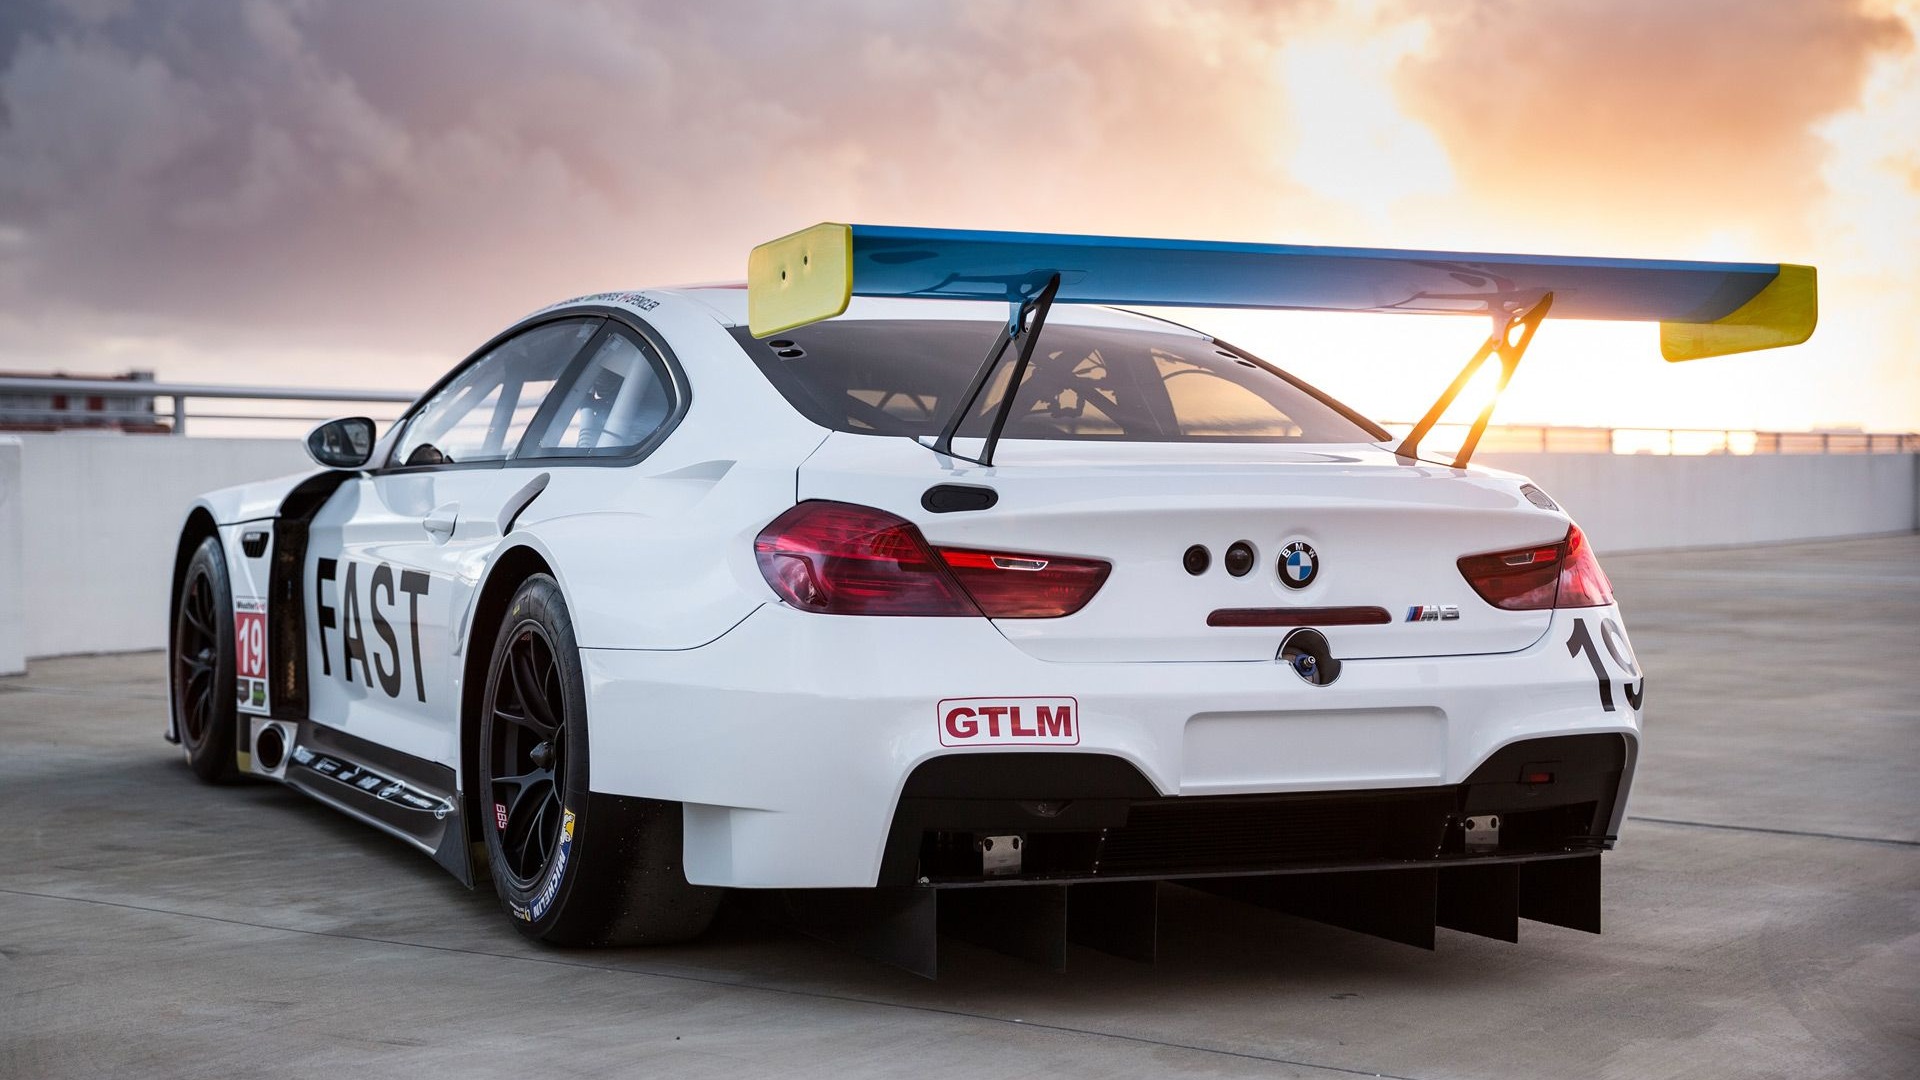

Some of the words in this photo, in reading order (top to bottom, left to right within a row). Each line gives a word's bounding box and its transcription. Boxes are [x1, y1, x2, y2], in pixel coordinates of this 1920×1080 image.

[1282, 543, 1317, 558] BMW
[316, 557, 430, 703] FAST
[1420, 605, 1460, 623] M6
[239, 618, 263, 675] 19
[1566, 617, 1644, 712] 19
[945, 706, 1073, 738] GTLM
[495, 803, 507, 829] BBS
[533, 849, 566, 918] MICHELIN
